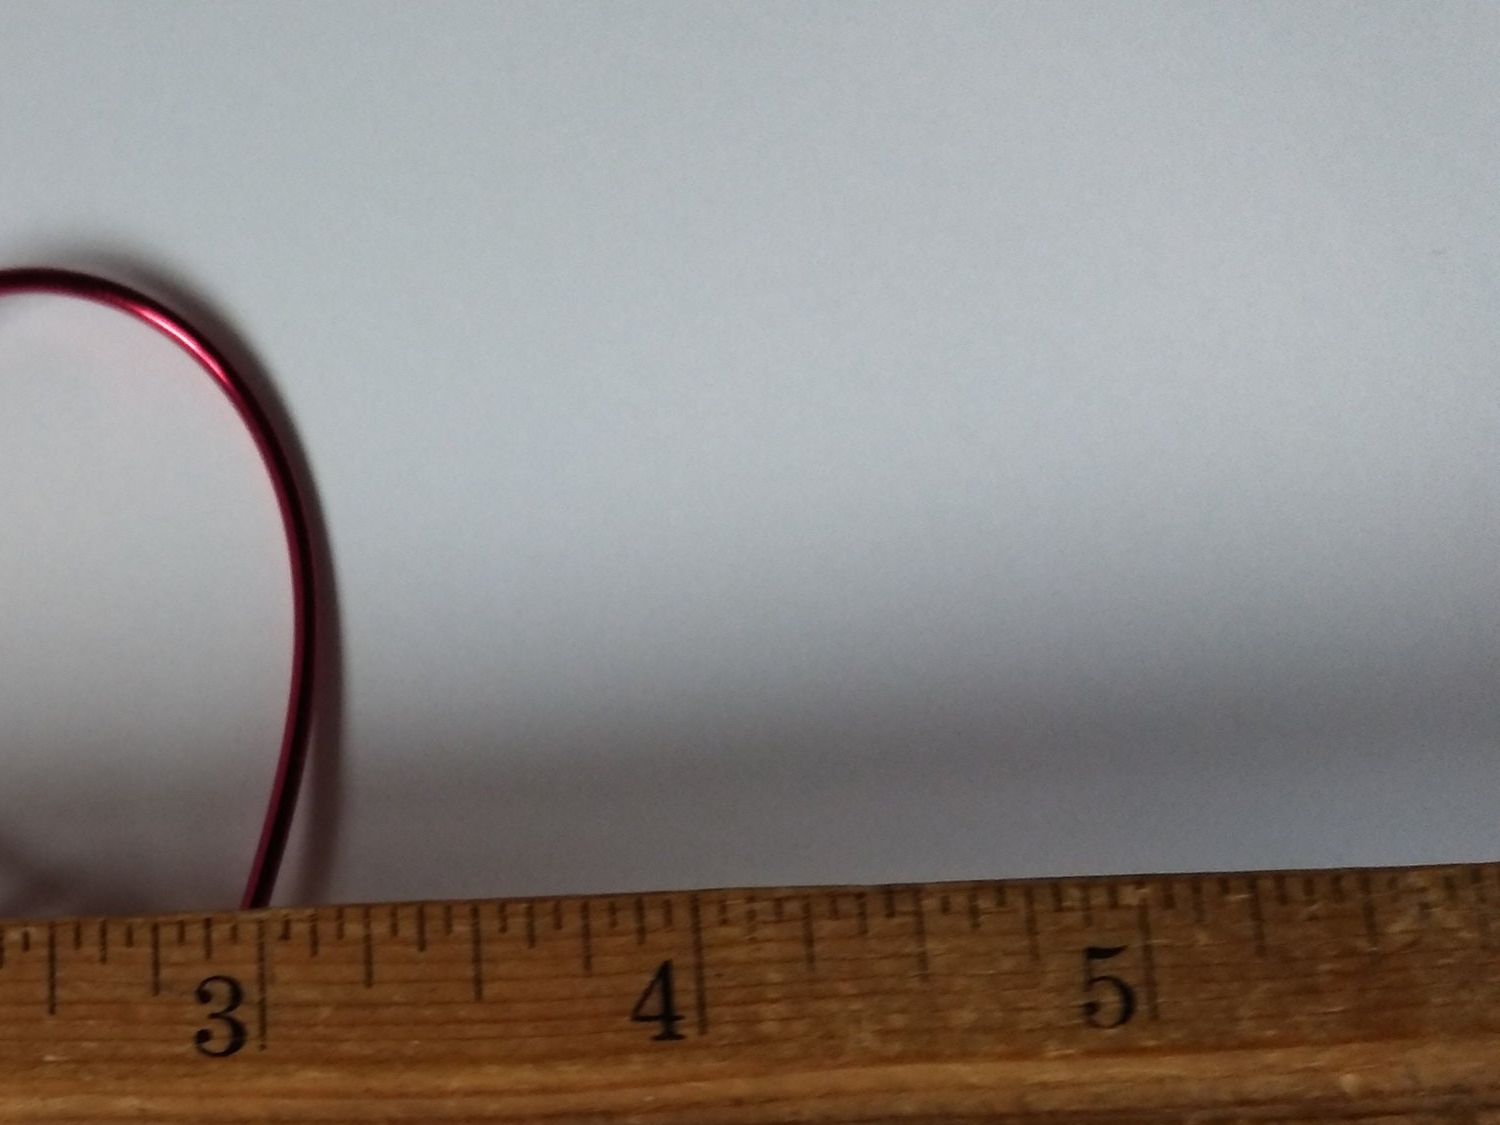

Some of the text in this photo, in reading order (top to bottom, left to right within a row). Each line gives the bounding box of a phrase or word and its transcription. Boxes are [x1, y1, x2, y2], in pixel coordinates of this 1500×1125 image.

[193, 975, 247, 1058] 3
[630, 959, 685, 1041] 4
[1082, 946, 1136, 1029] 5
